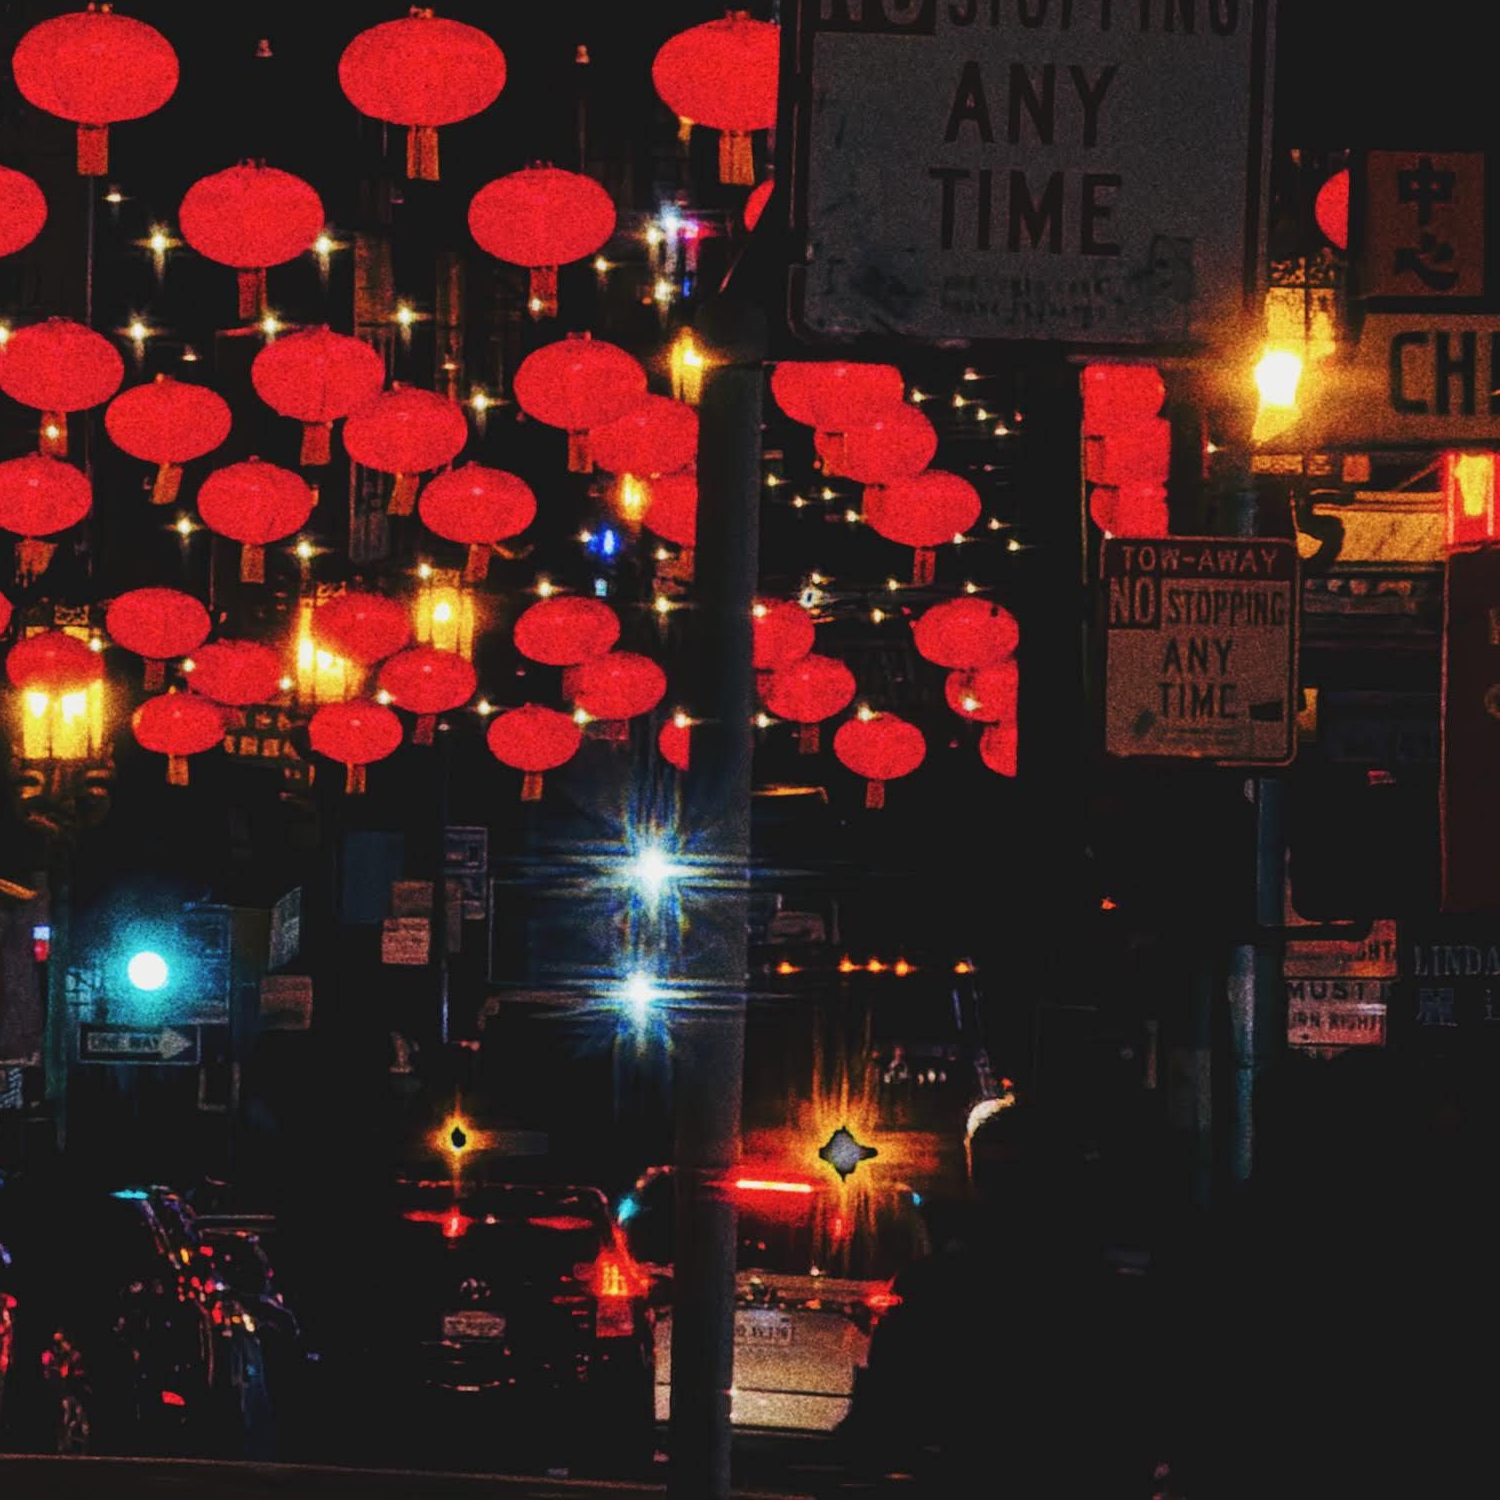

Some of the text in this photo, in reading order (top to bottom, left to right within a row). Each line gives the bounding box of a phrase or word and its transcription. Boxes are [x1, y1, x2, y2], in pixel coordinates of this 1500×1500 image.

[944, 60, 1118, 149] ANY
[929, 167, 1123, 256] TIME
[1121, 544, 1278, 575] TOW-AWAY
[1108, 575, 1285, 627] NO STOPPING
[1162, 636, 1233, 676] ANY
[1158, 682, 1237, 719] TIME
